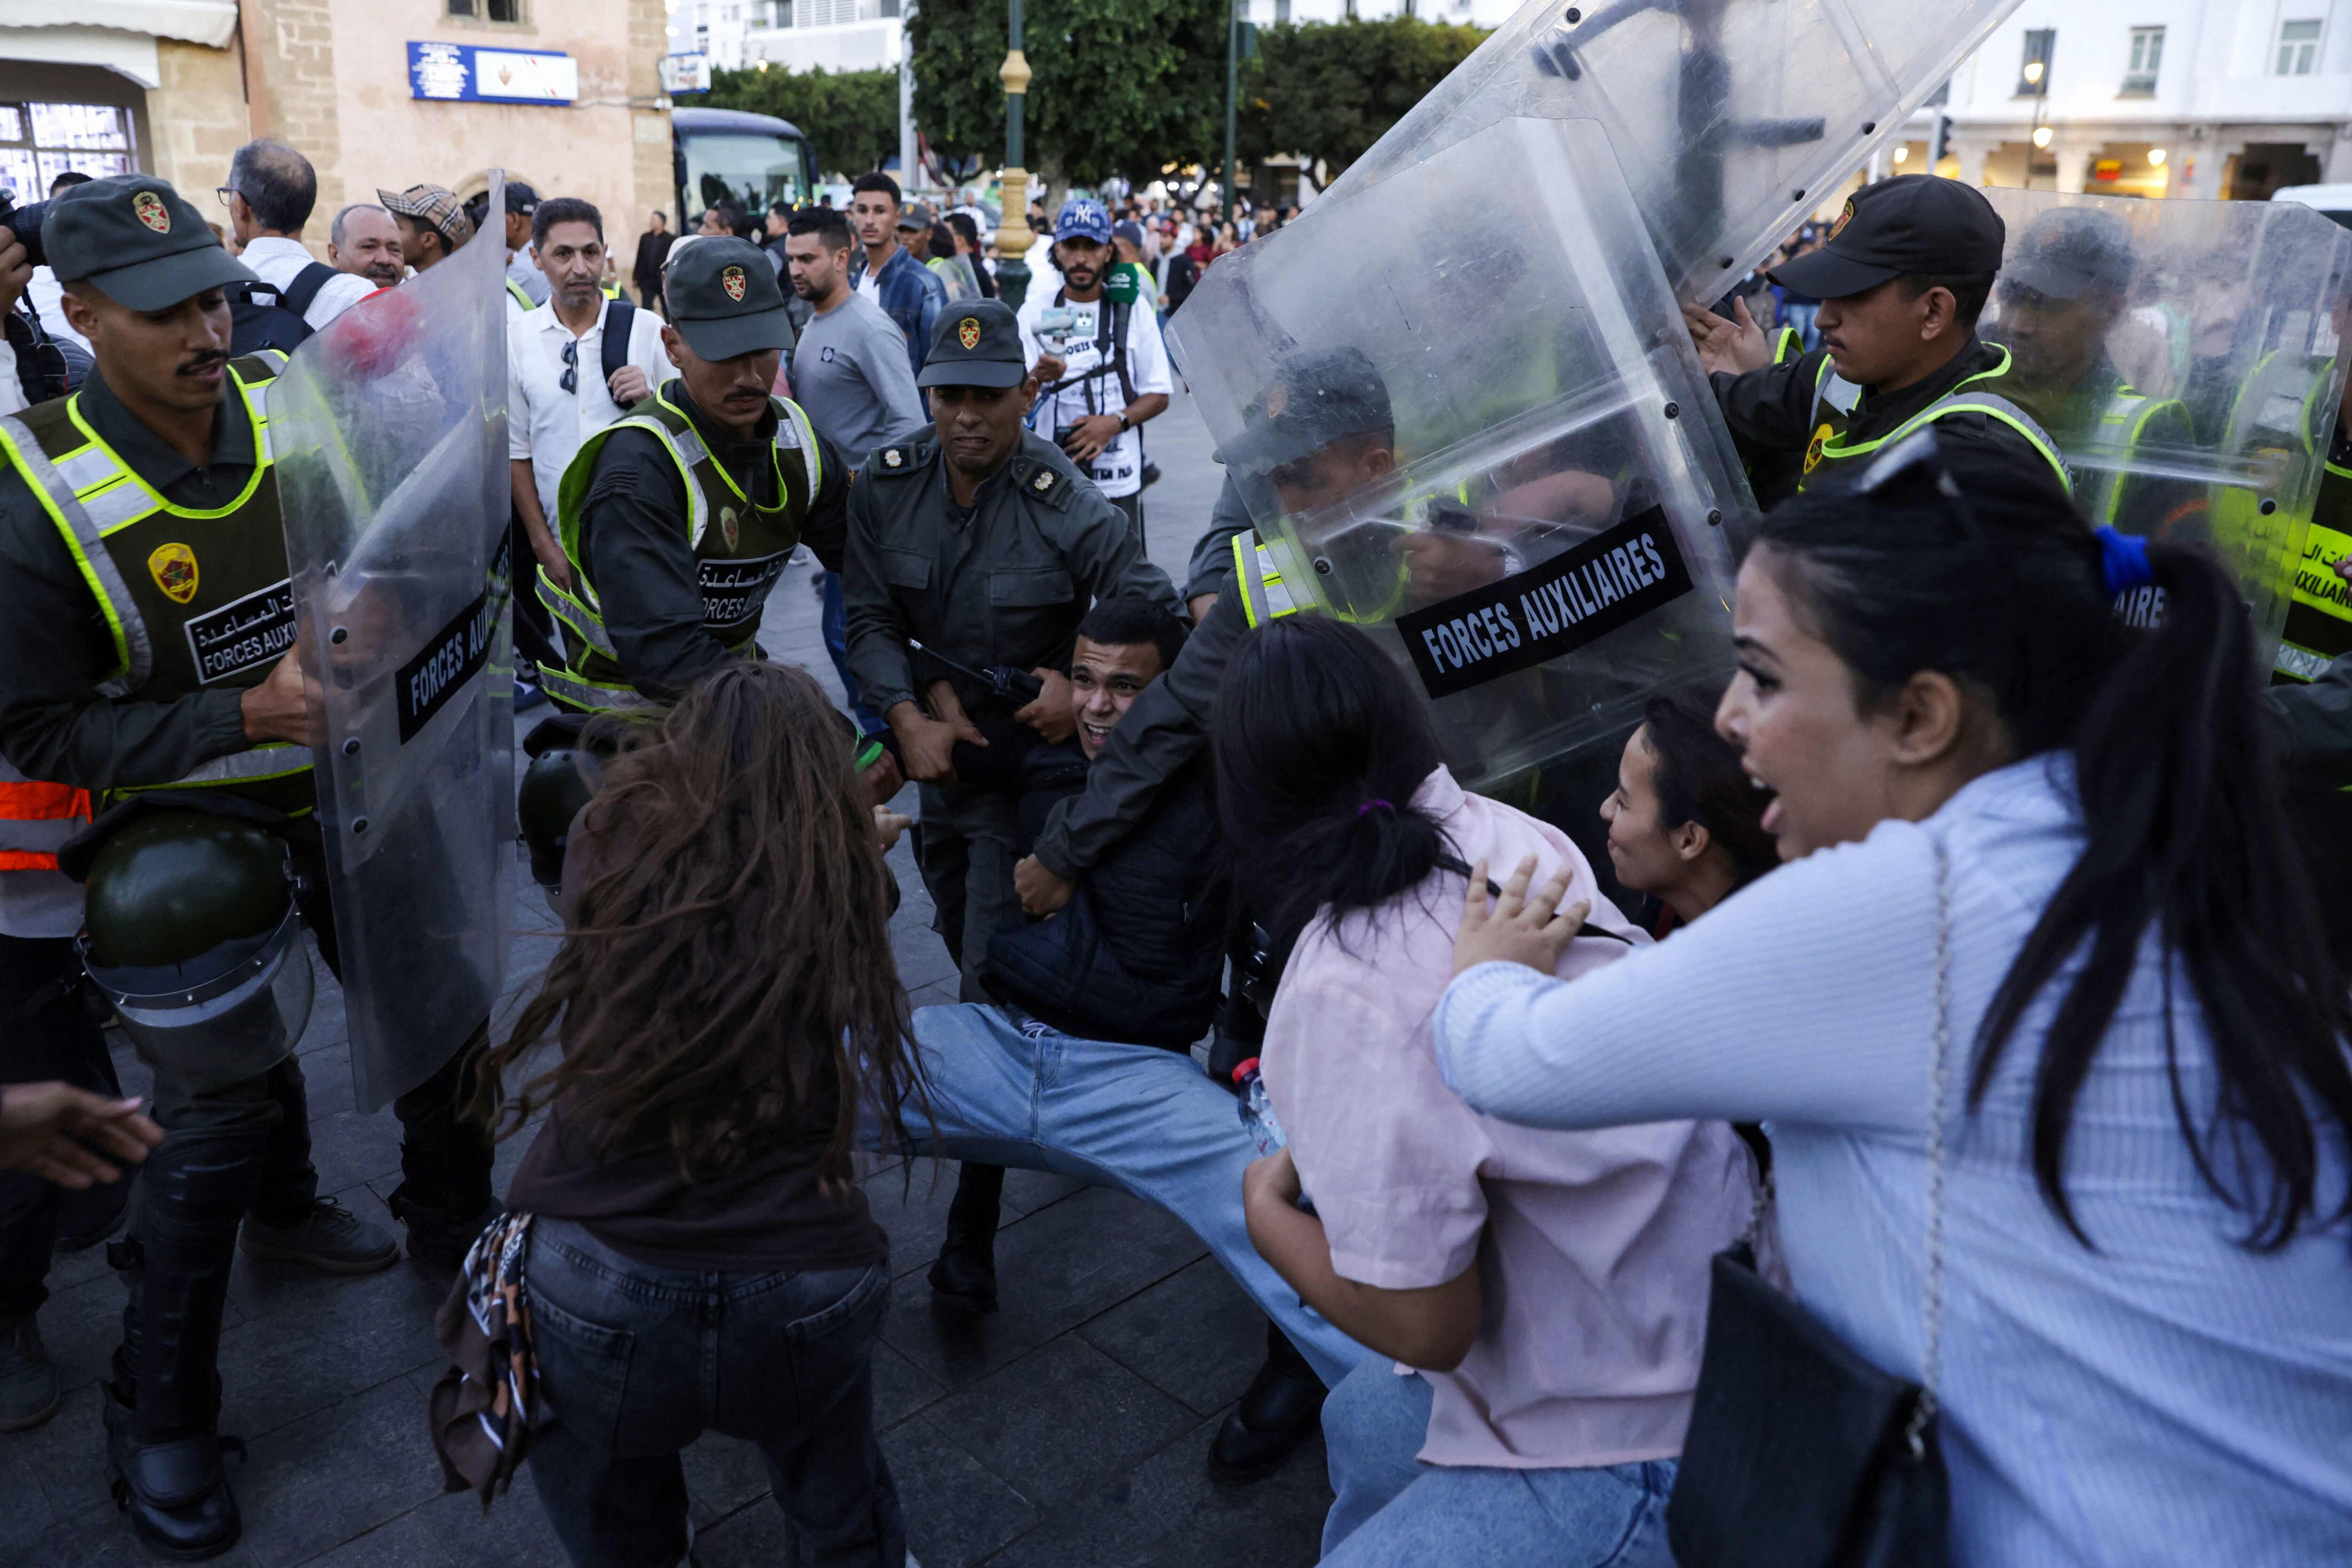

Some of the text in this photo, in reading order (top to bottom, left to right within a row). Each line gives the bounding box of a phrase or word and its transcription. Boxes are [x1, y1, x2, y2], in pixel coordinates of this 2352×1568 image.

[1421, 533, 1666, 674] FORCES AUXILIAIRES
[204, 636, 263, 674] FORCES
[411, 631, 464, 716] FORCES
